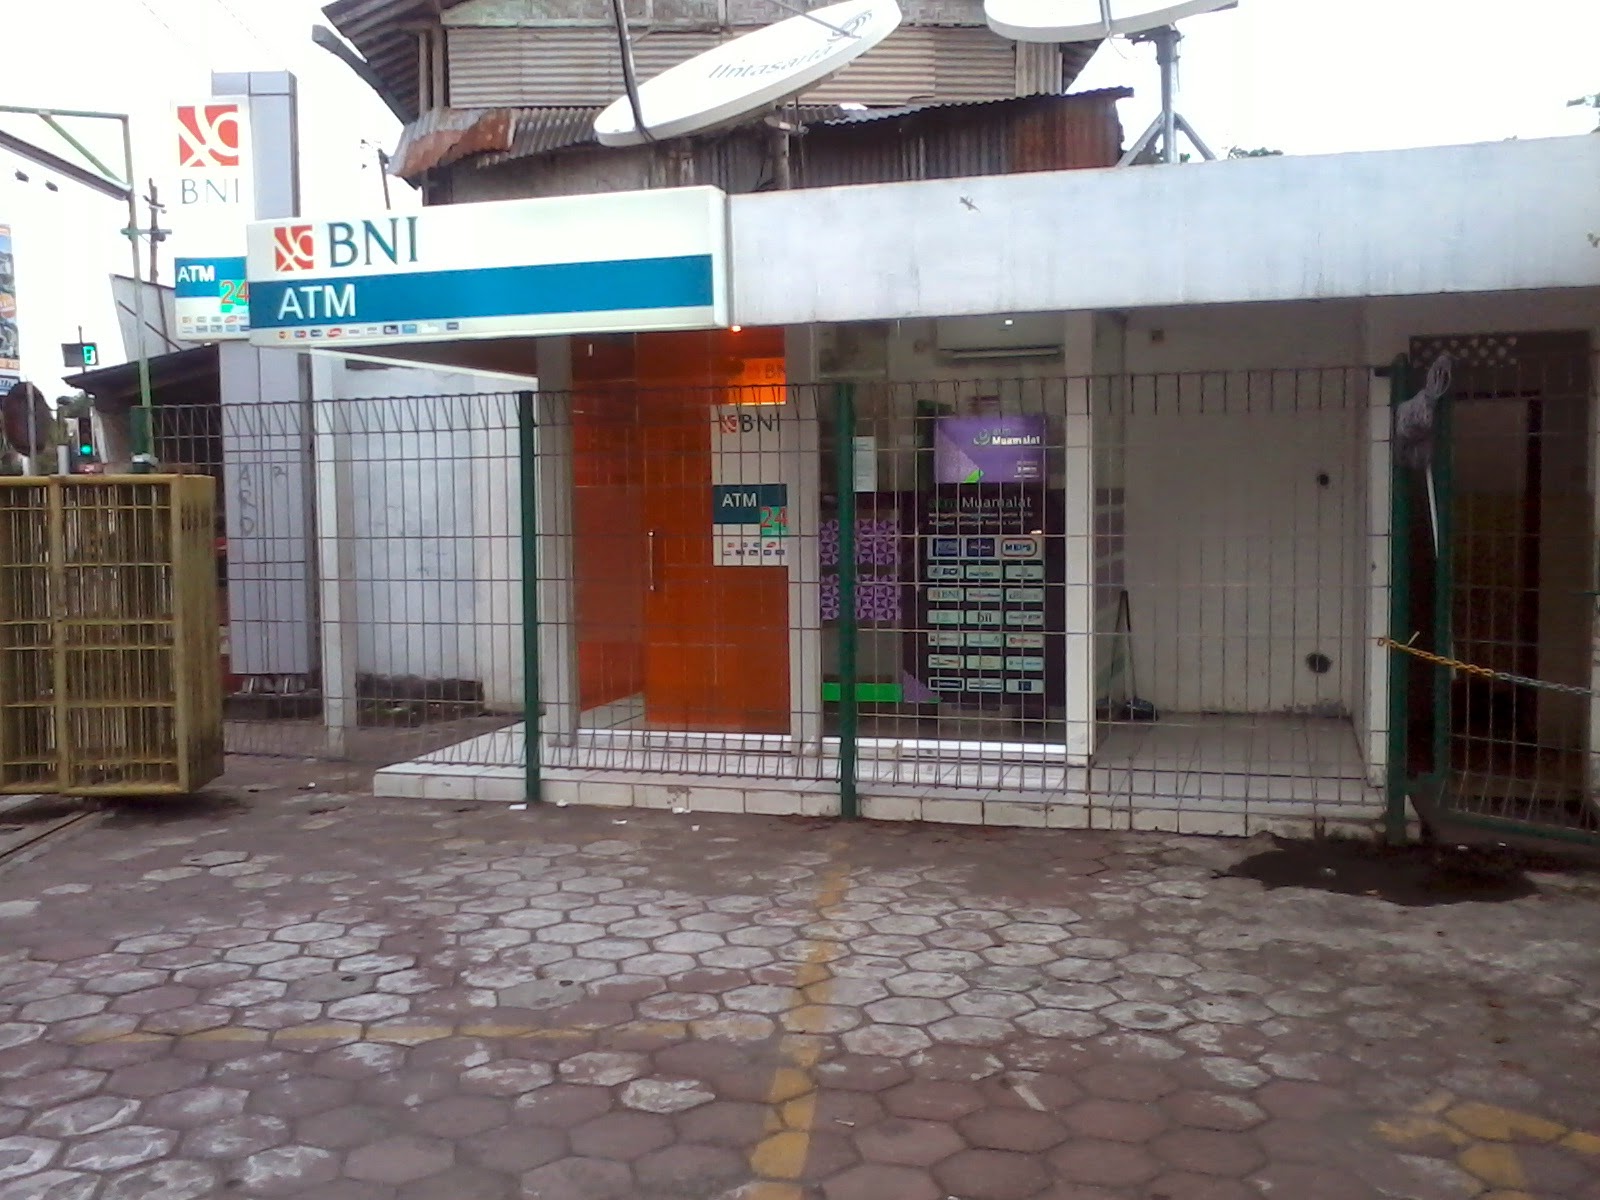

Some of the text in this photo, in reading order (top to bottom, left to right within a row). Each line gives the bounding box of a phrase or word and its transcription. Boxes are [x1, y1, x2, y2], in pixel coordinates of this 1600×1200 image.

[181, 177, 240, 205] BNI
[327, 216, 418, 268] BNI
[177, 264, 215, 283] ATM
[219, 280, 249, 305] 24
[277, 283, 356, 321] ATM
[740, 413, 780, 433] BNI
[991, 434, 1040, 446] Muamalat
[722, 492, 757, 508] ATM
[961, 496, 1032, 508] Muamalat
[760, 506, 788, 528] 24
